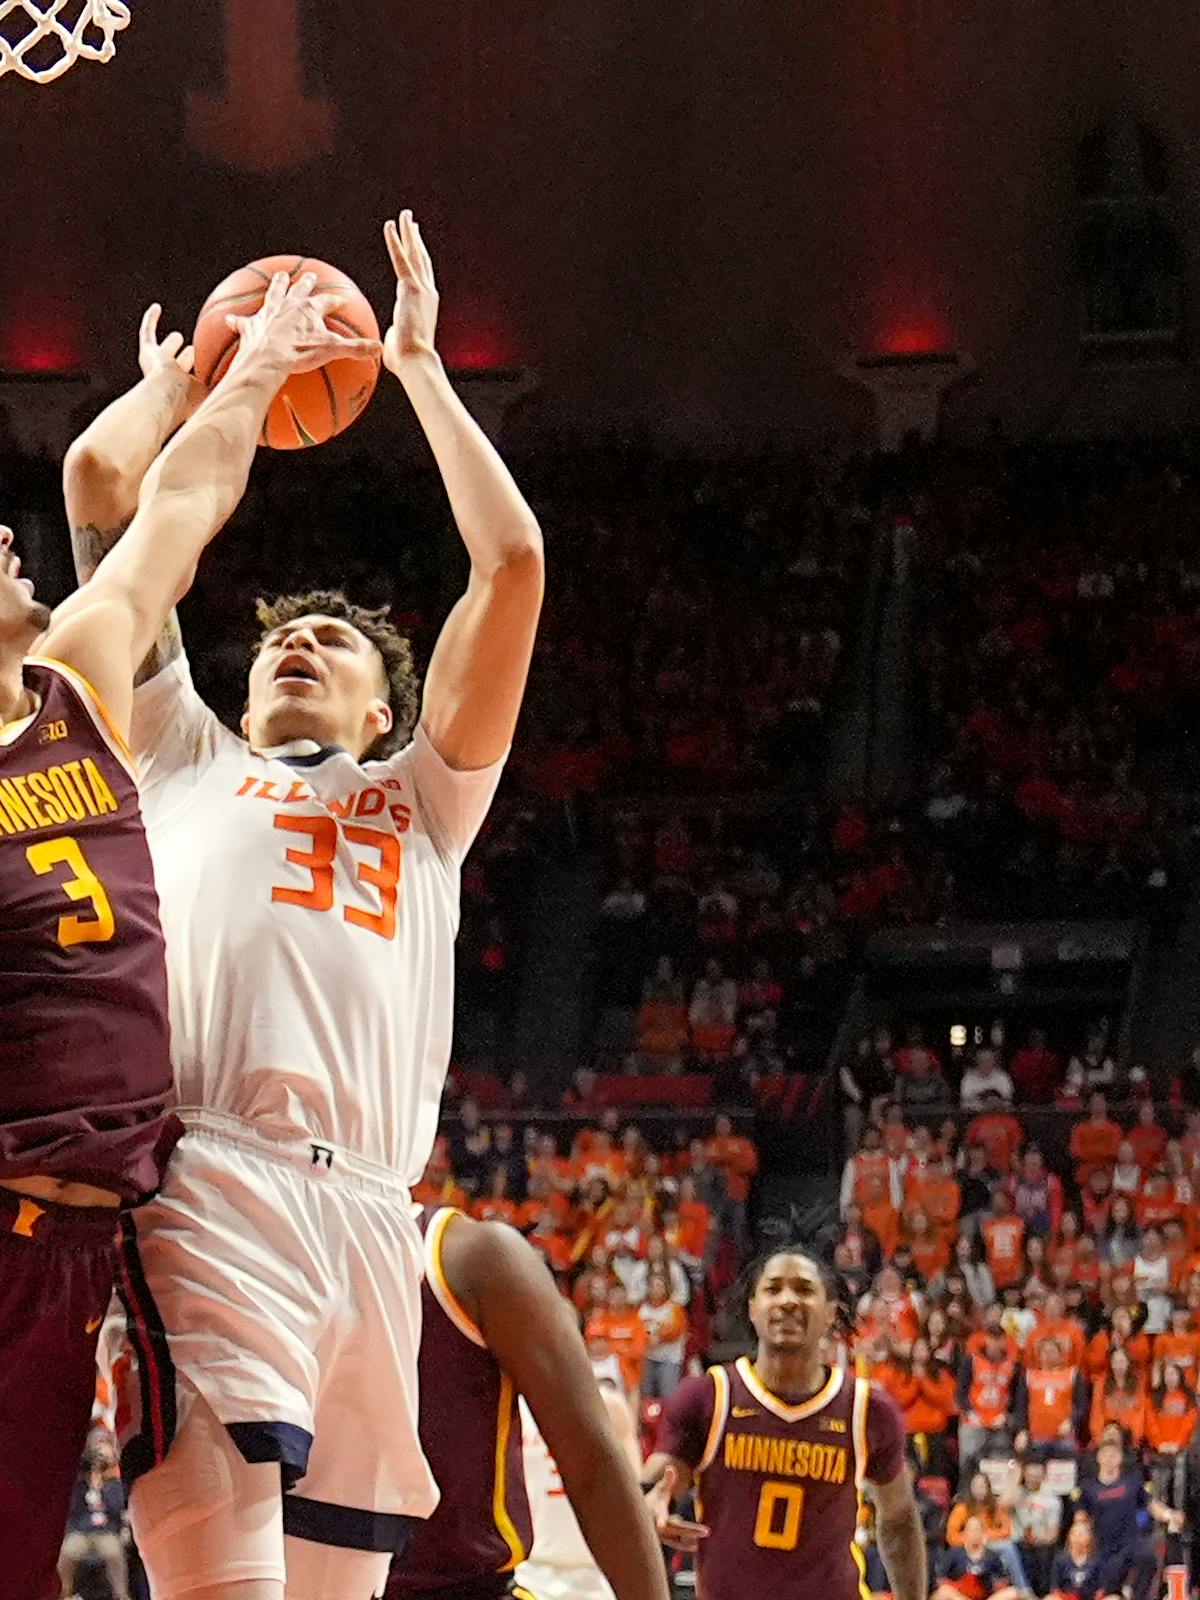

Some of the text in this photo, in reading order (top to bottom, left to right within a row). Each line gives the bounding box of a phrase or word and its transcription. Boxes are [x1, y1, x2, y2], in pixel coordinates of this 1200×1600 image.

[25, 835, 116, 948] 3
[271, 813, 402, 941] 33
[724, 1431, 848, 1485] MINNESOTA
[753, 1480, 805, 1551] 0
